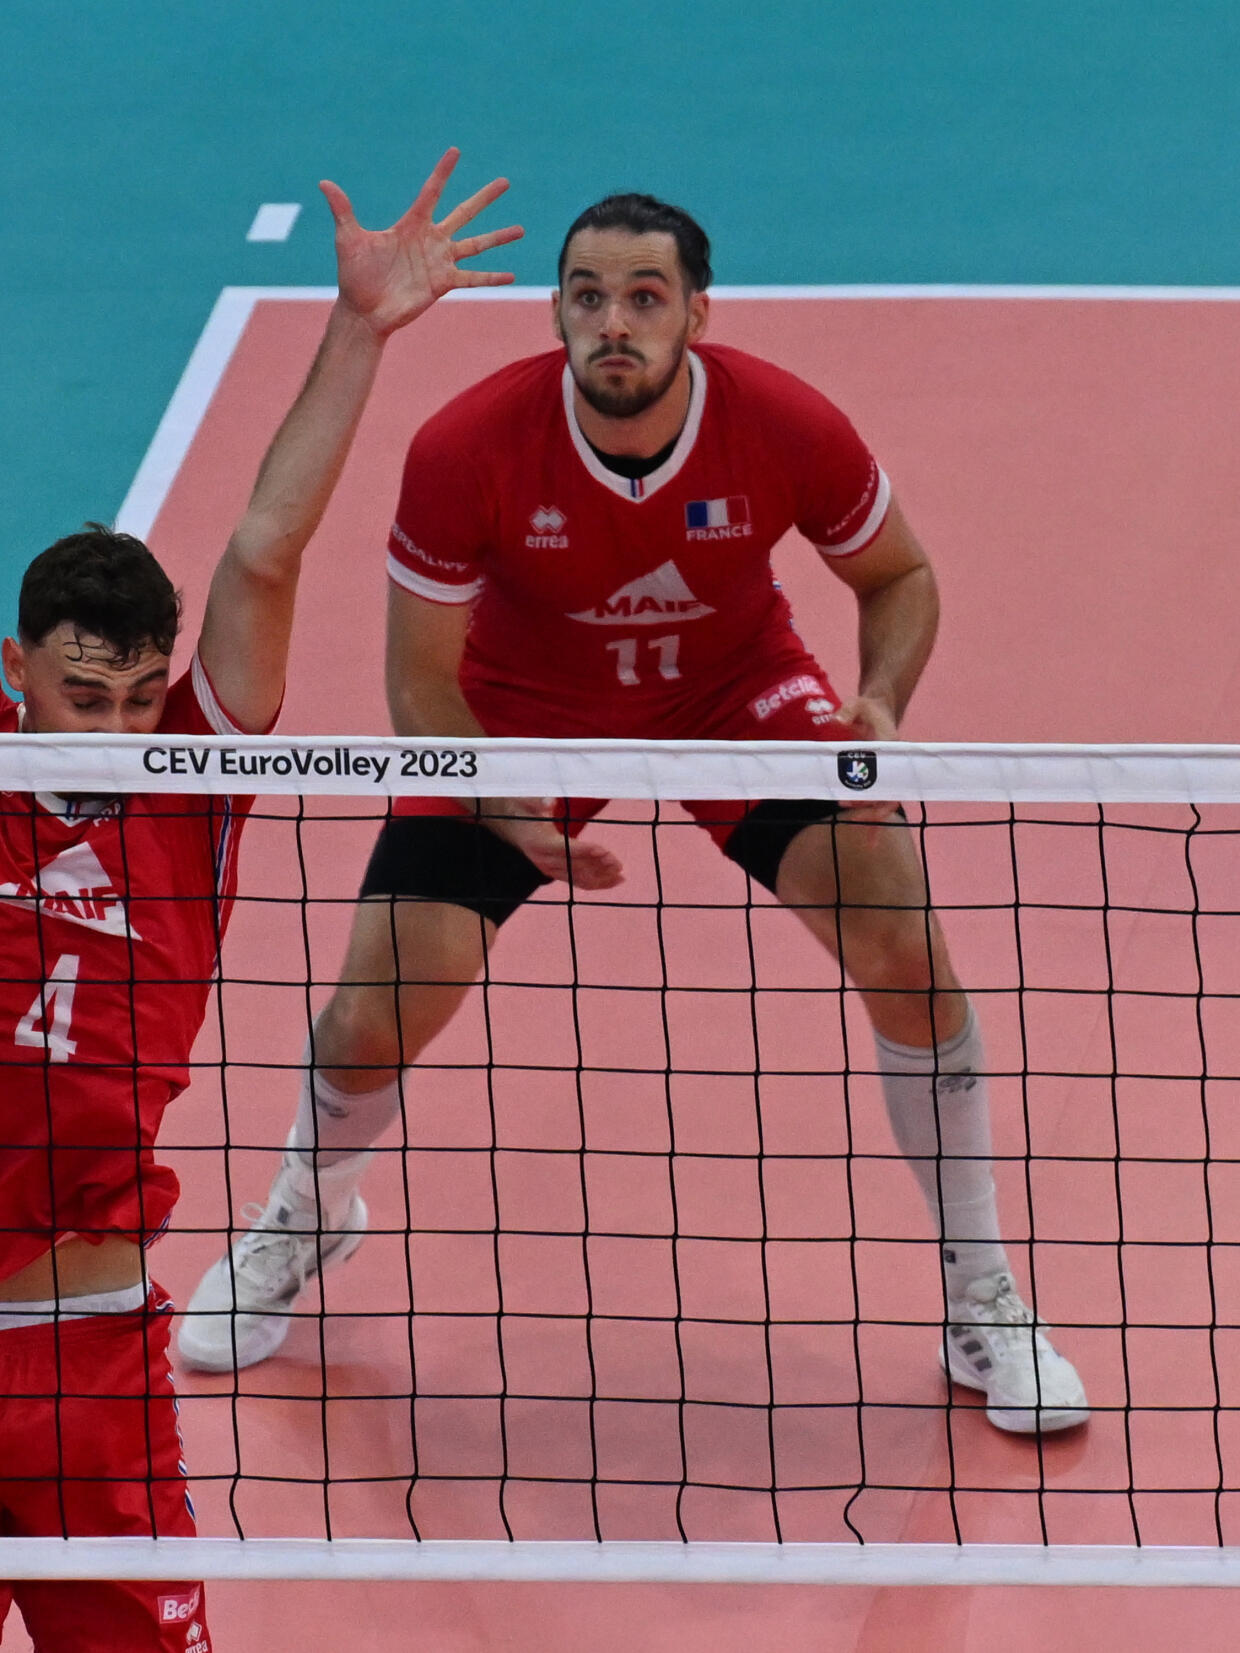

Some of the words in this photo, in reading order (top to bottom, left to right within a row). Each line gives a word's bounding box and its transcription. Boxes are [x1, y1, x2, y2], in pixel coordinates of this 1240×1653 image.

[686, 523, 752, 541] FRANCE
[594, 596, 703, 618] MAIF
[606, 634, 683, 686] 11
[143, 746, 210, 774] CEV
[220, 748, 390, 782] EuroVolley
[400, 749, 478, 777] 2023
[14, 953, 80, 1064] 4
